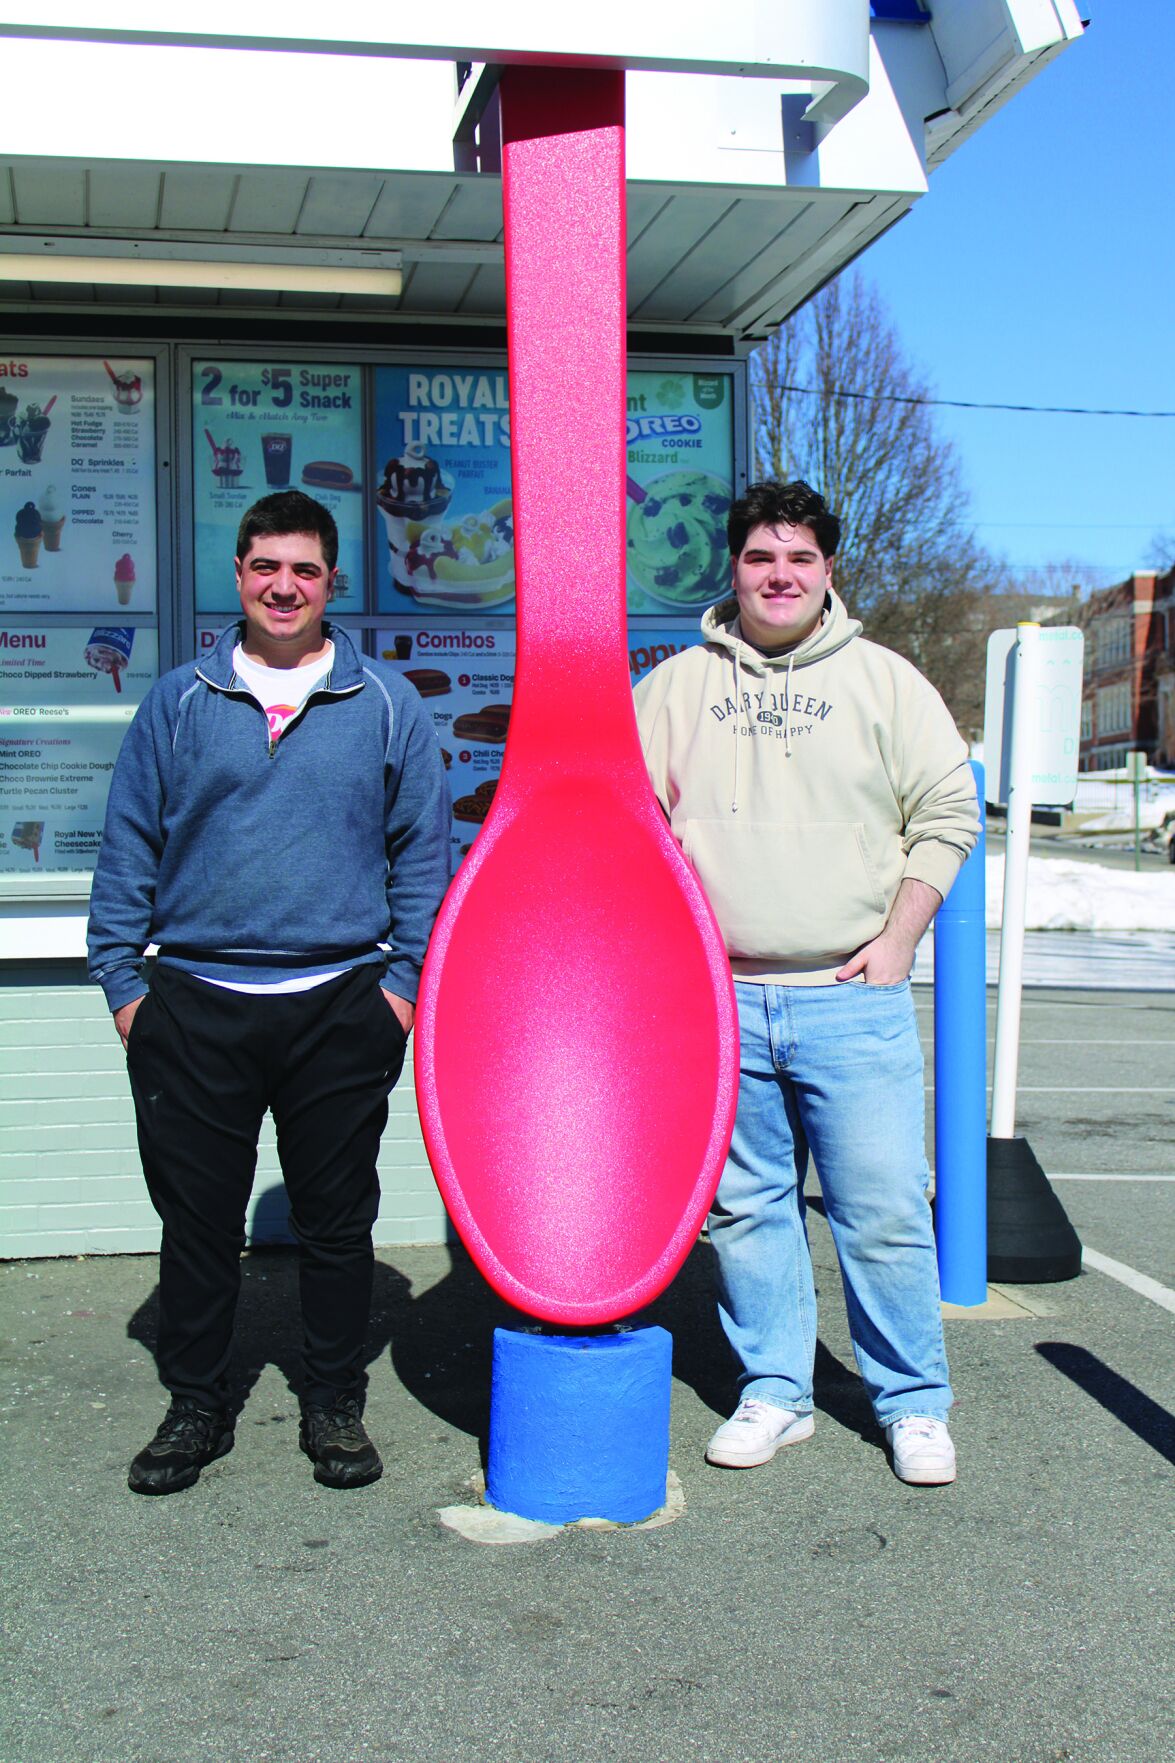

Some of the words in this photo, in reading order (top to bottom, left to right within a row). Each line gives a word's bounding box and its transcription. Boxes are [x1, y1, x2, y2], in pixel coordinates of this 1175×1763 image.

[300, 370, 351, 391] Super
[201, 366, 224, 406] 2
[229, 385, 261, 406] for
[261, 368, 293, 408] $5
[409, 374, 509, 408] ROYAL
[71, 395, 104, 403] Sundaes
[300, 391, 352, 409] Snack
[84, 421, 103, 430] Fudge
[627, 415, 701, 442] OREO
[71, 428, 106, 437] Strawberry
[662, 439, 702, 448] COOKIE
[628, 450, 678, 463] Blizzard
[71, 459, 84, 467] DQ
[88, 459, 125, 469] Sprinkles
[5, 469, 32, 477] Parfait
[112, 531, 133, 539] Cherry
[416, 631, 496, 649] Combos
[629, 643, 688, 675] ppy
[24, 671, 52, 680] Dipped
[53, 671, 98, 680] Strawberry
[472, 674, 499, 682] Classic
[13, 708, 36, 716] OREO
[39, 708, 70, 716] Reese's
[434, 713, 453, 721] Dogs
[760, 713, 779, 725] 190
[41, 763, 59, 772] Chip
[89, 763, 115, 772] Dough
[50, 787, 78, 795] Cluster
[54, 831, 76, 839] Royal
[54, 840, 101, 848] Cheesecake
